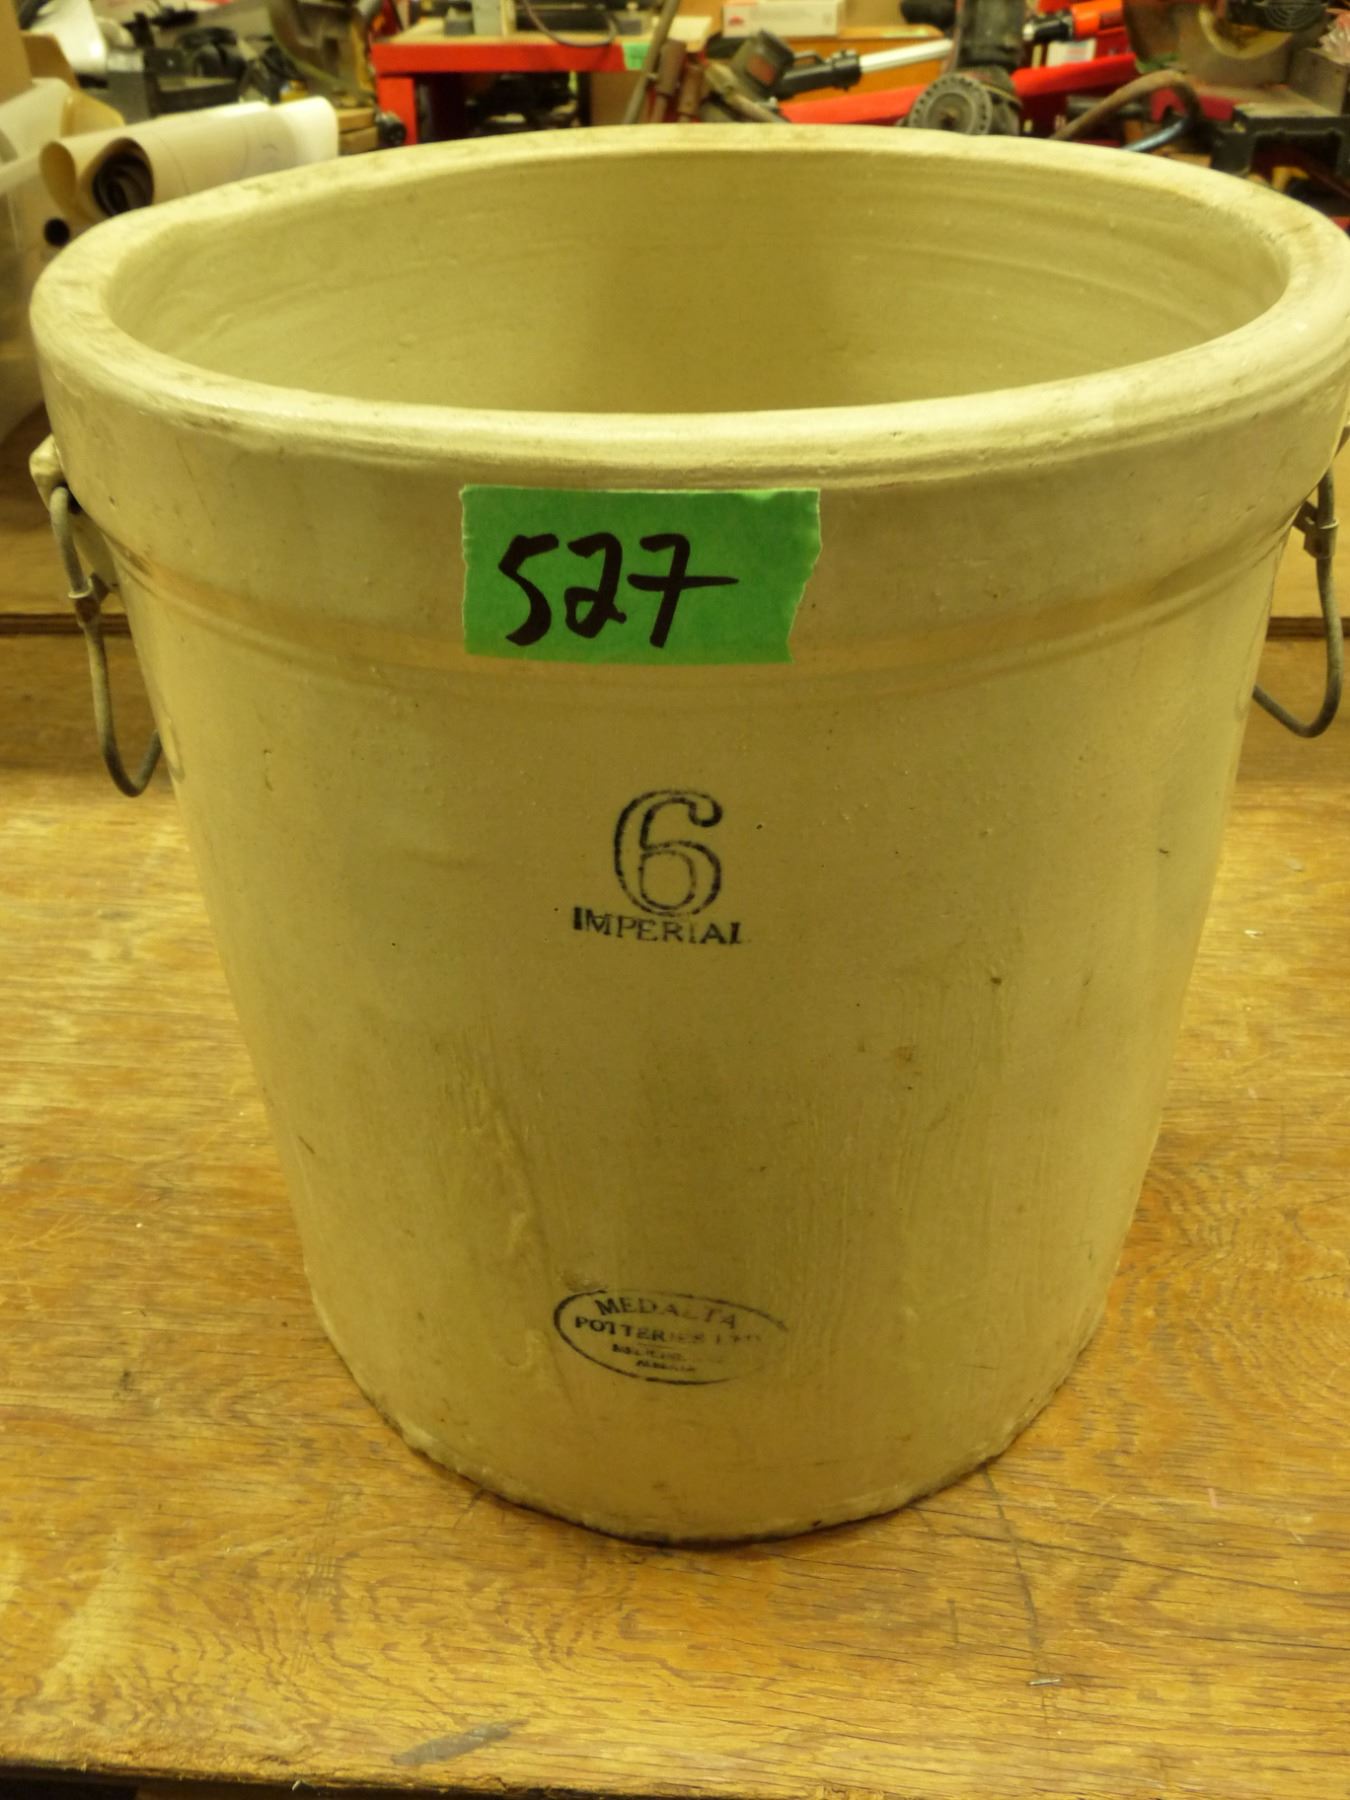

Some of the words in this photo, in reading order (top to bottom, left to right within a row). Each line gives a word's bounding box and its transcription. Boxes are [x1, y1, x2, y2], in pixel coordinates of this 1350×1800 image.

[498, 532, 740, 649] 527
[613, 789, 723, 918] 6
[572, 906, 742, 945] IMPERIAL
[594, 1296, 737, 1330] MEDALTA
